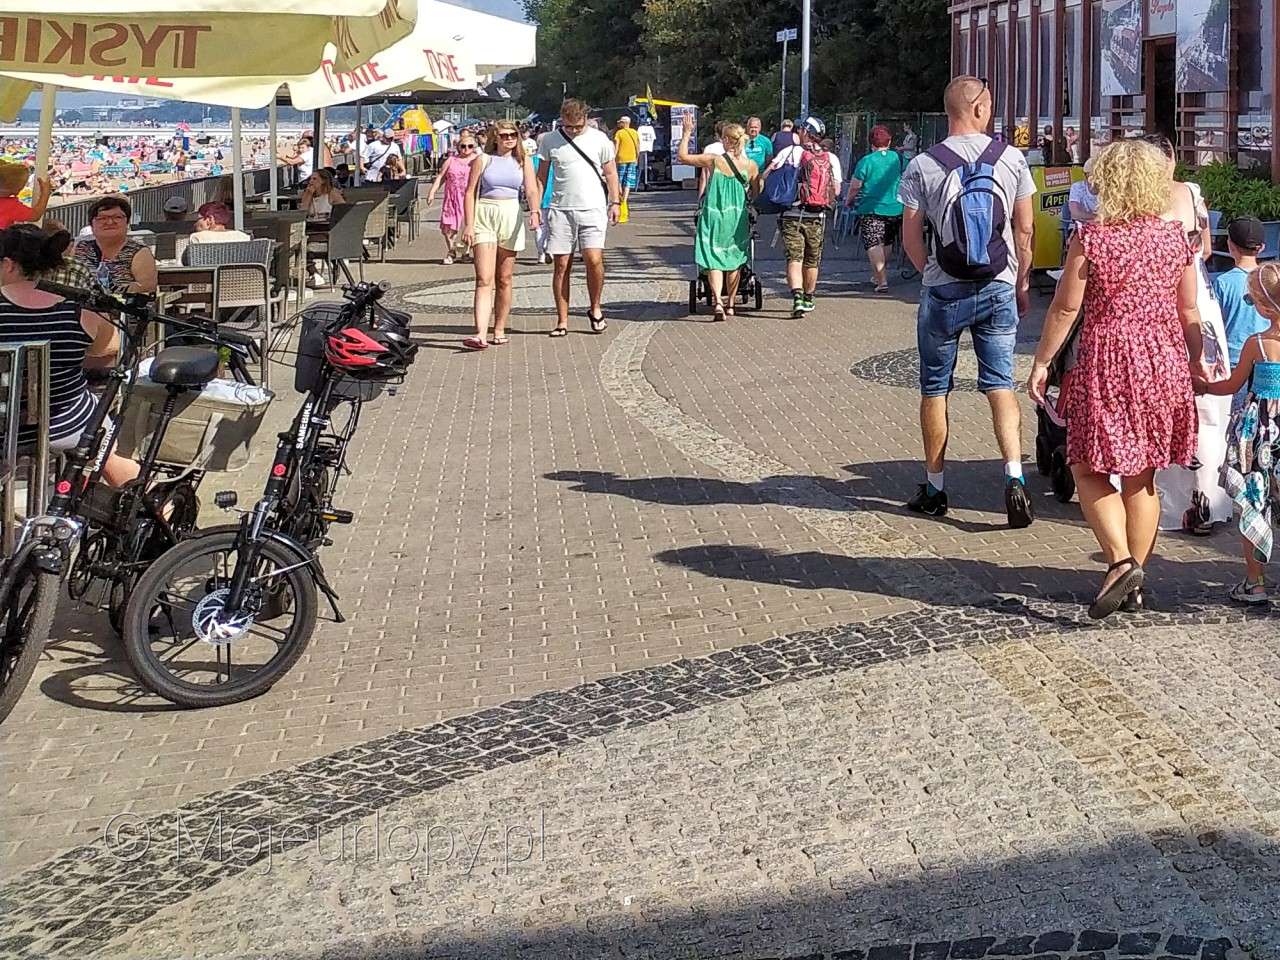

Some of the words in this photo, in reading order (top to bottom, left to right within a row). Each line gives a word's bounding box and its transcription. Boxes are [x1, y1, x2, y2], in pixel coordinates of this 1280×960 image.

[1045, 194, 1070, 208] APER
[93, 424, 116, 472] SAMEBIKE
[295, 402, 314, 449] SAMEBIKE
